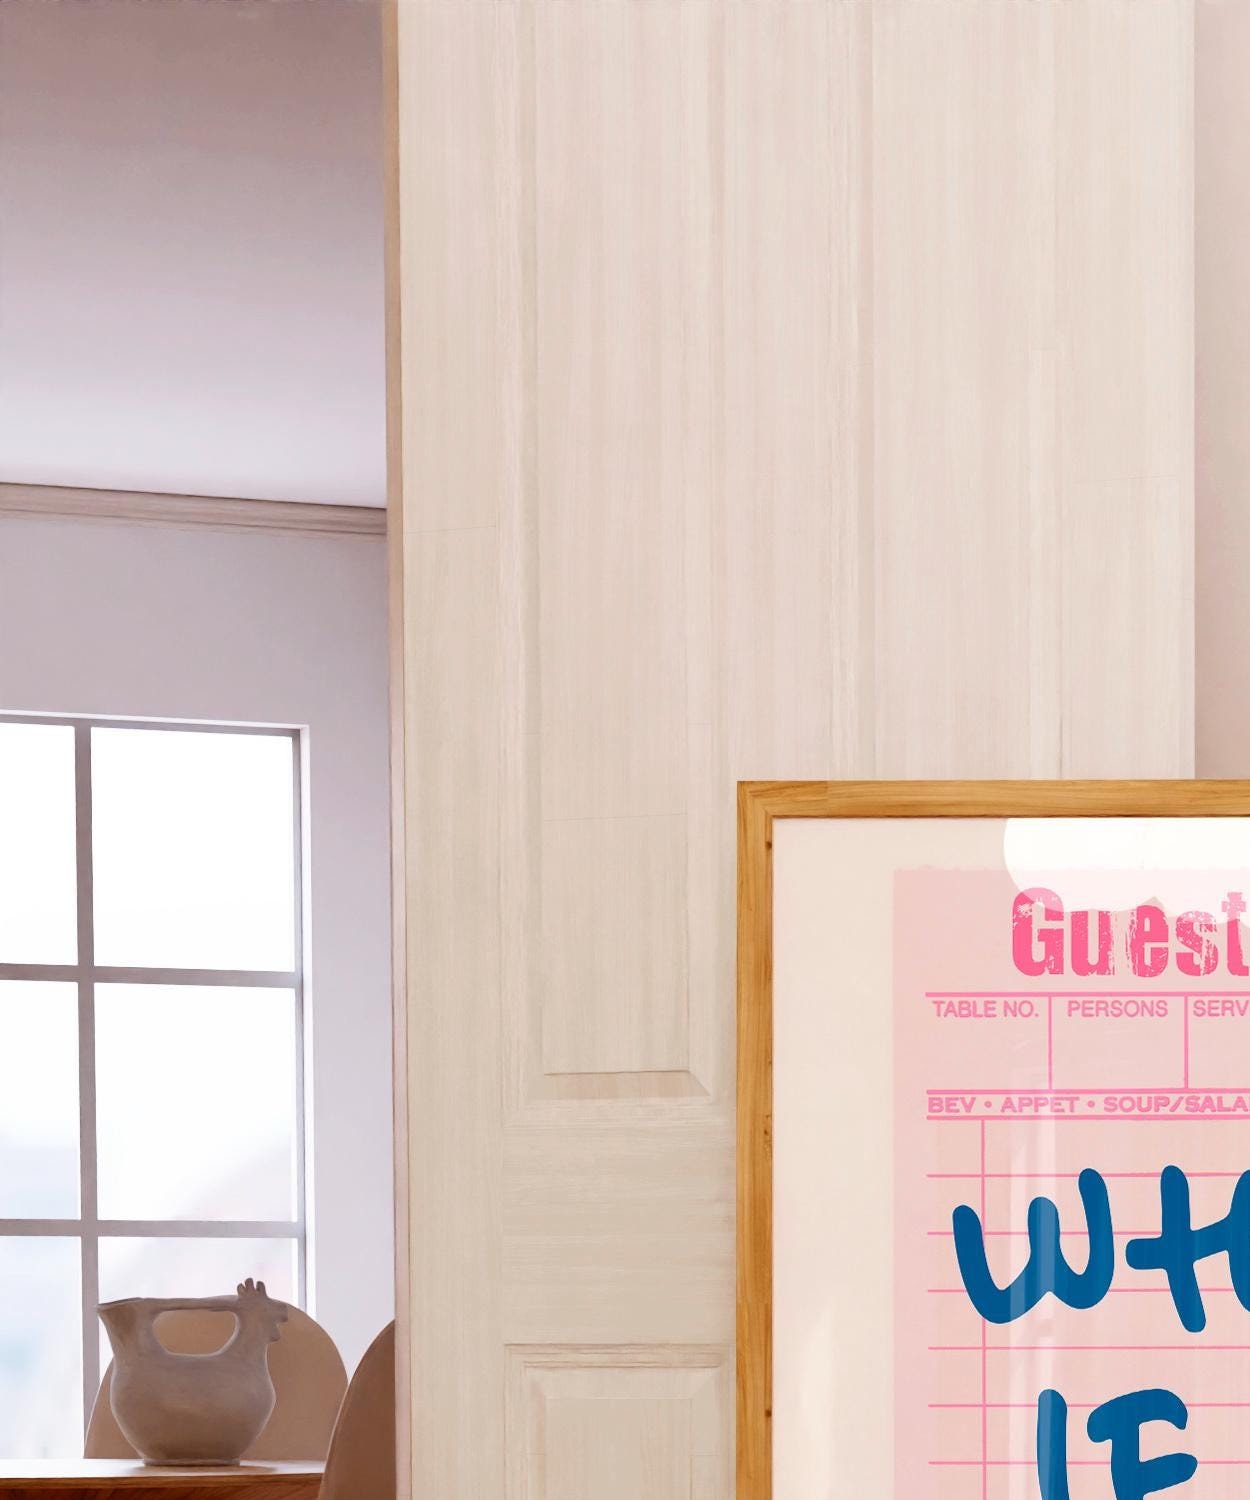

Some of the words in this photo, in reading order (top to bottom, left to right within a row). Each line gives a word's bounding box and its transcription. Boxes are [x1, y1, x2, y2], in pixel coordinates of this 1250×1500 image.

[933, 1000, 997, 1018] TABLE
[1003, 1000, 1039, 1018] NO.
[1067, 999, 1168, 1018] PERSONS
[927, 1096, 976, 1113] BEV
[1000, 1096, 1080, 1113] APPET
